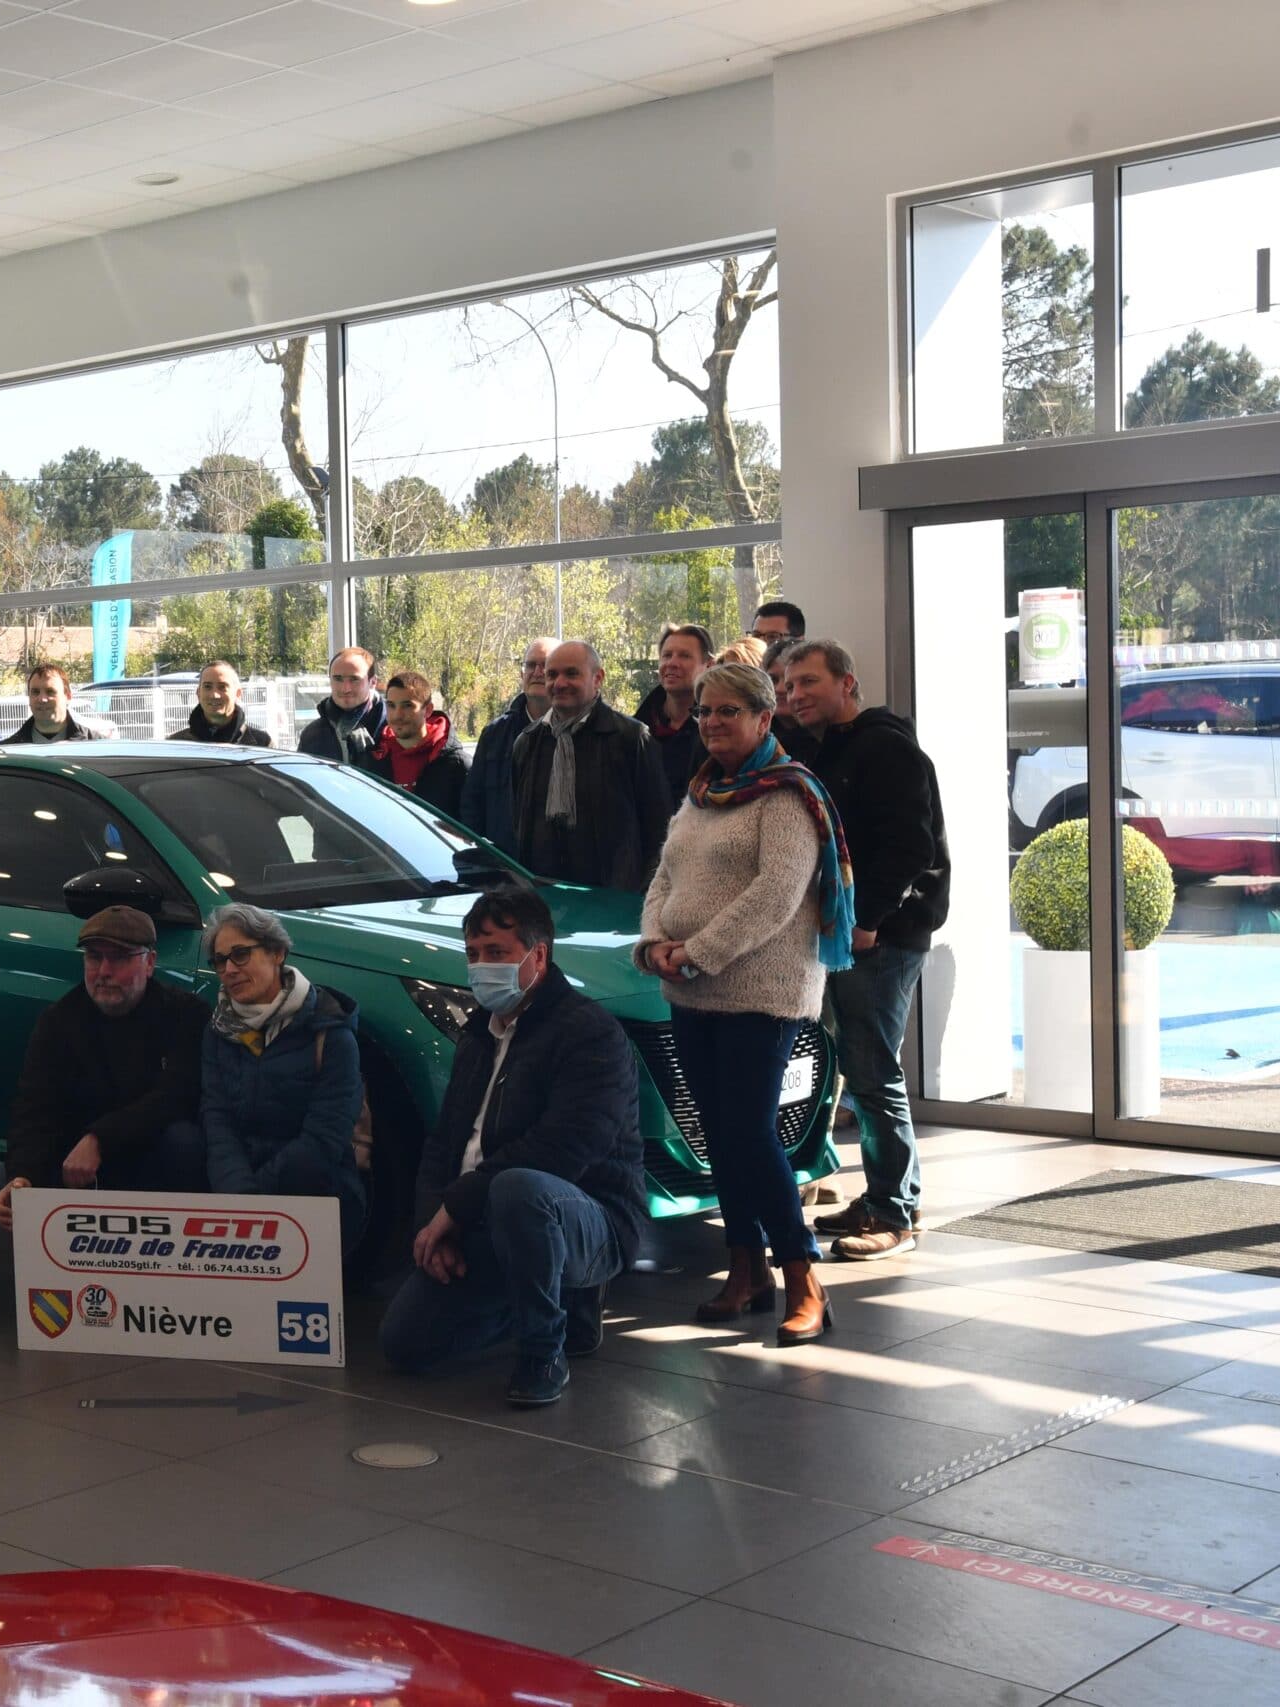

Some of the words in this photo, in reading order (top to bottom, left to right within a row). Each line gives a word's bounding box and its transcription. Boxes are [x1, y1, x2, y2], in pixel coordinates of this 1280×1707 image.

[66, 1214, 171, 1236] 205
[182, 1217, 279, 1241] GTI
[69, 1235, 133, 1255] Club
[138, 1238, 176, 1257] de
[182, 1240, 282, 1261] France
[68, 1259, 162, 1271] www.club205gti.fr
[203, 1263, 282, 1275] 06.74.43.51.51
[85, 1287, 107, 1302] 30
[123, 1304, 233, 1338] Nièvre
[279, 1312, 329, 1343] 58
[962, 1559, 1015, 1576] ICI
[1018, 1571, 1269, 1639] D'ATTENDRE
